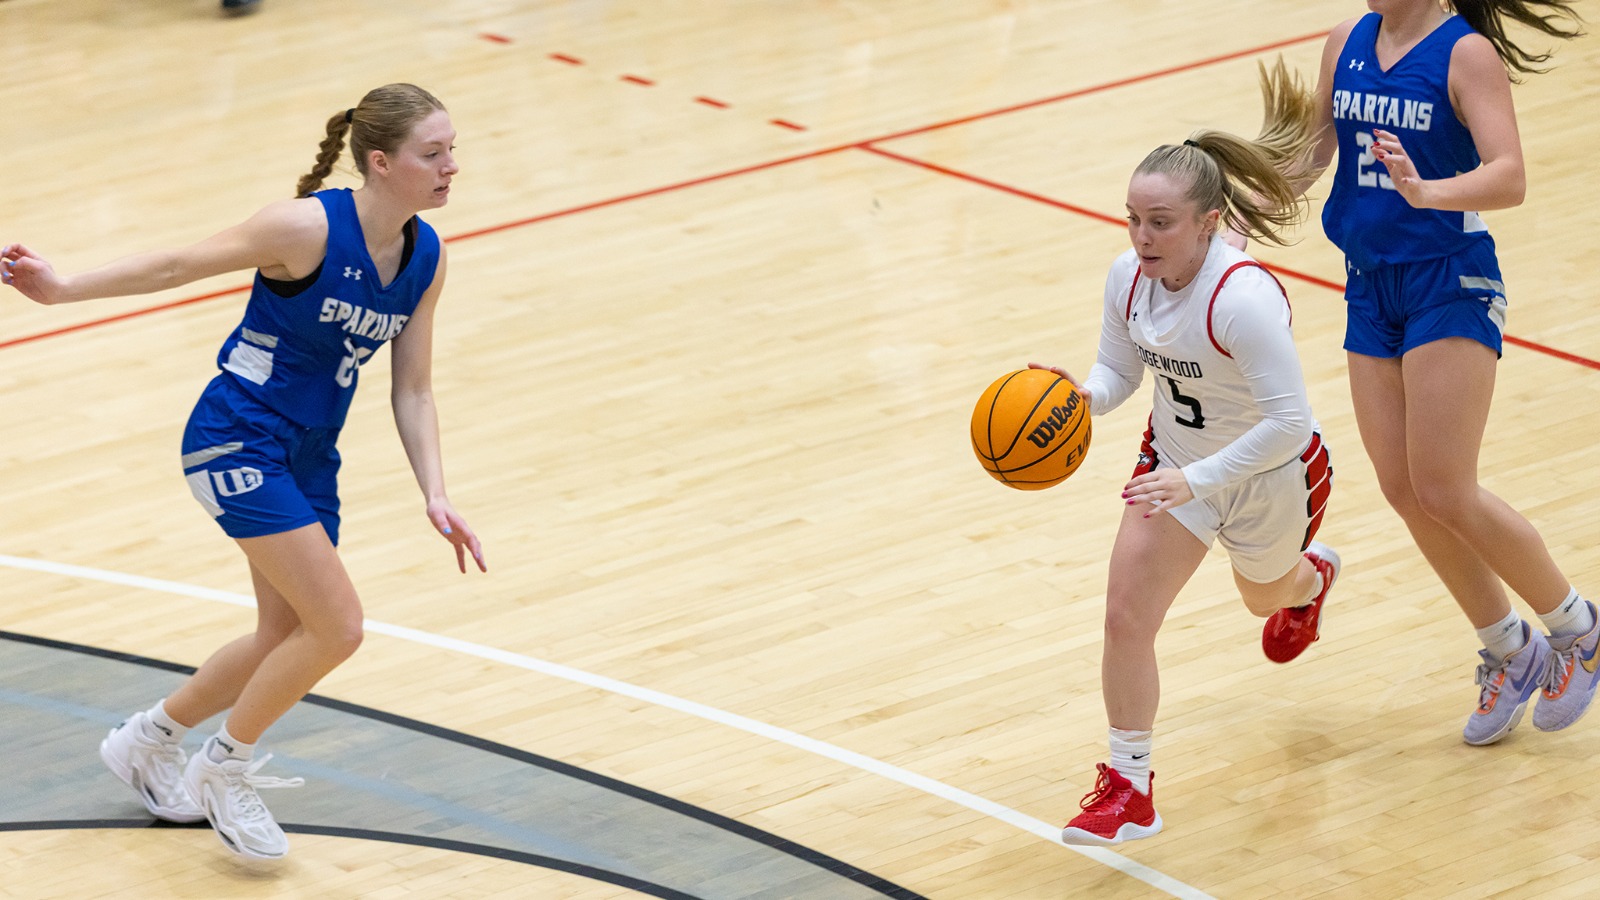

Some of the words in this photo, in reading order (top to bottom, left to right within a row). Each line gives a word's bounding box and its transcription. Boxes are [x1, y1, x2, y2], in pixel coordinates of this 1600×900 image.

[1333, 89, 1434, 131] SPARTANS
[1026, 389, 1081, 449] Wilson
[1159, 374, 1205, 429] 5
